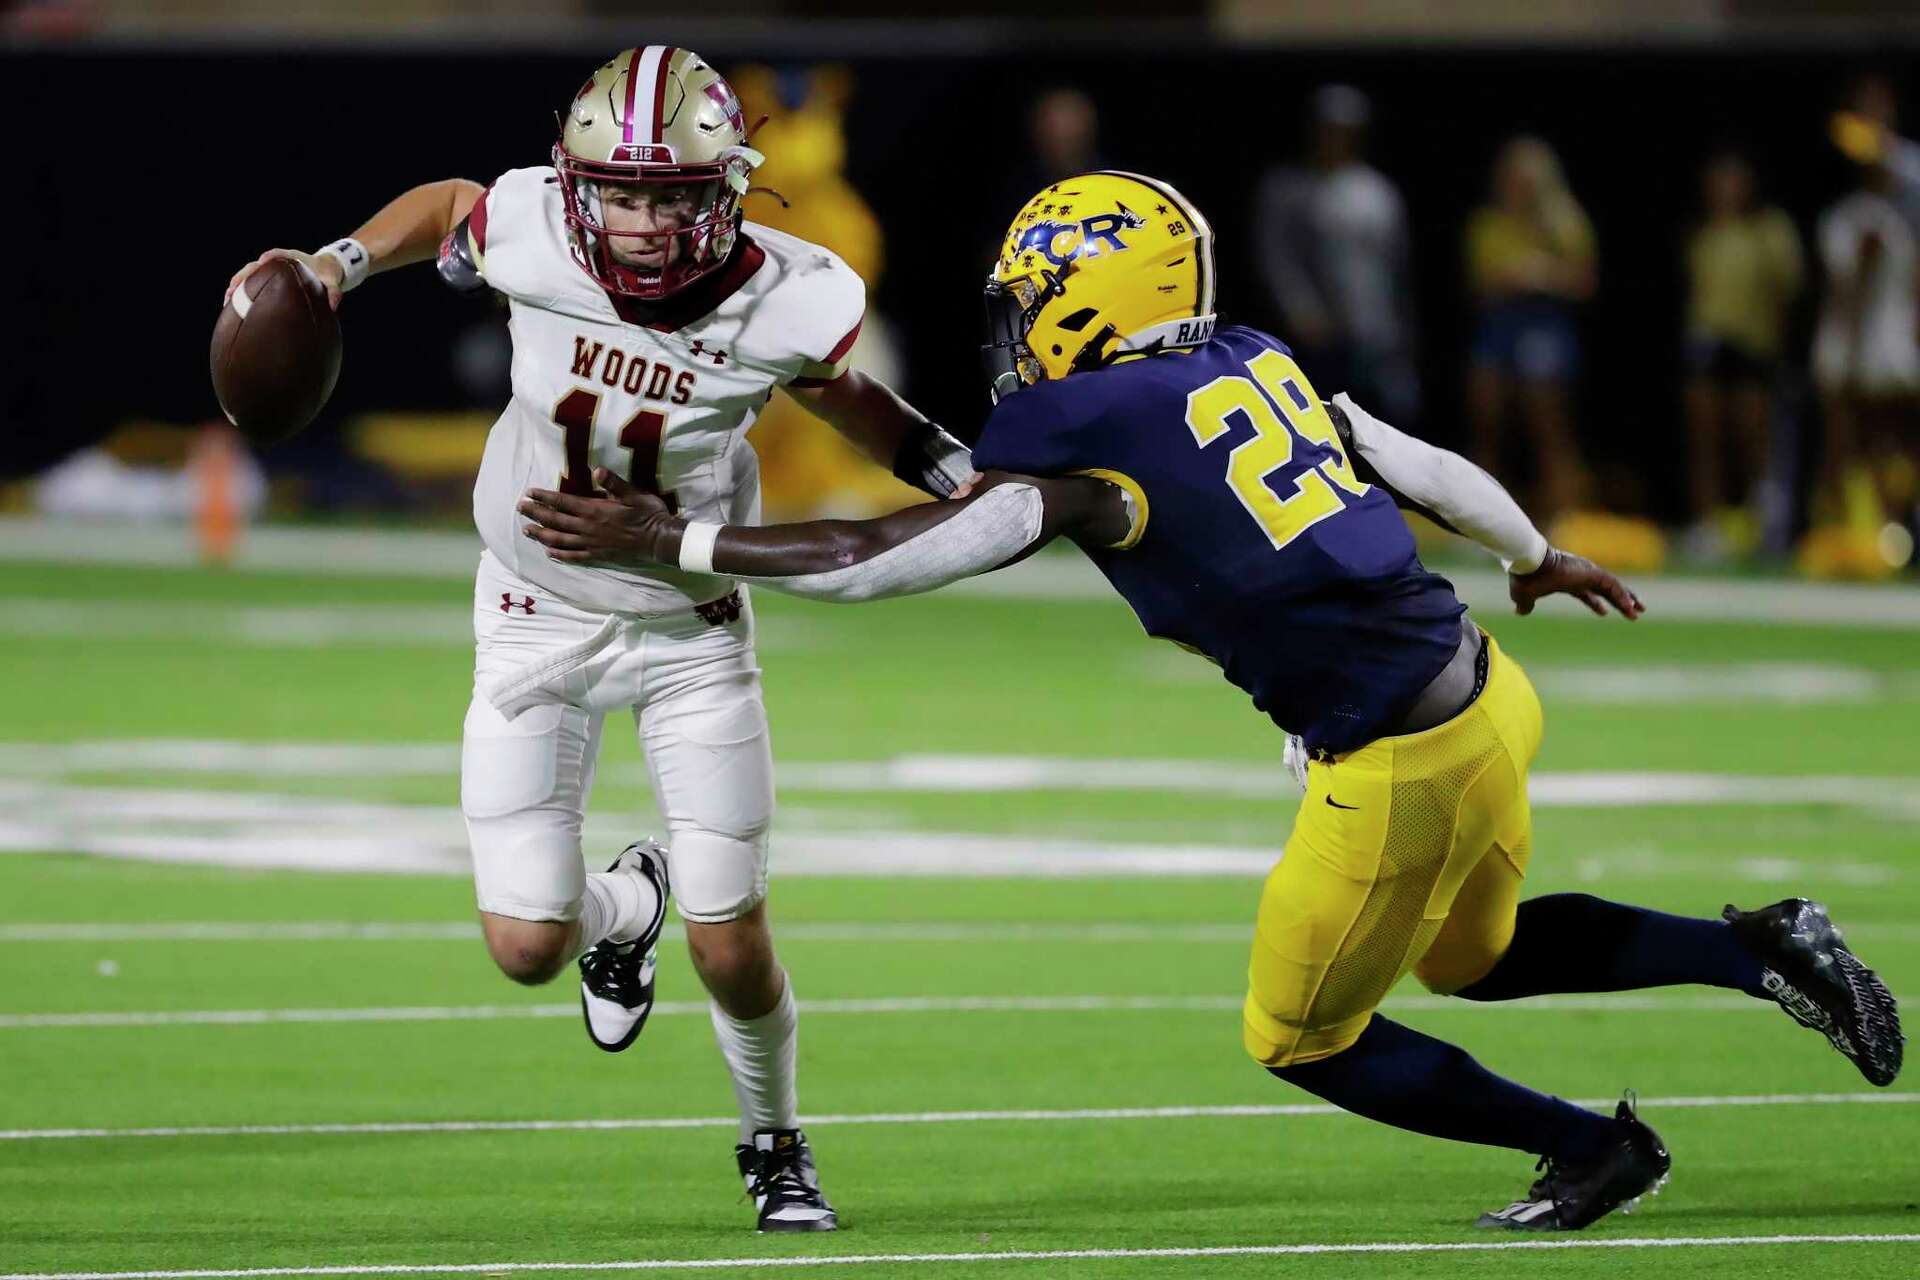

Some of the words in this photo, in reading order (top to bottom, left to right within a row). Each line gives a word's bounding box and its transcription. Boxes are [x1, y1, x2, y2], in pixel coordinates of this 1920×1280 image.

[630, 147, 652, 160] 212
[1014, 211, 1135, 266] CR
[1167, 221, 1185, 236] 29
[1175, 320, 1215, 343] RAN
[570, 334, 697, 405] WOODS
[552, 386, 681, 516] 11
[1185, 348, 1371, 551] 29
